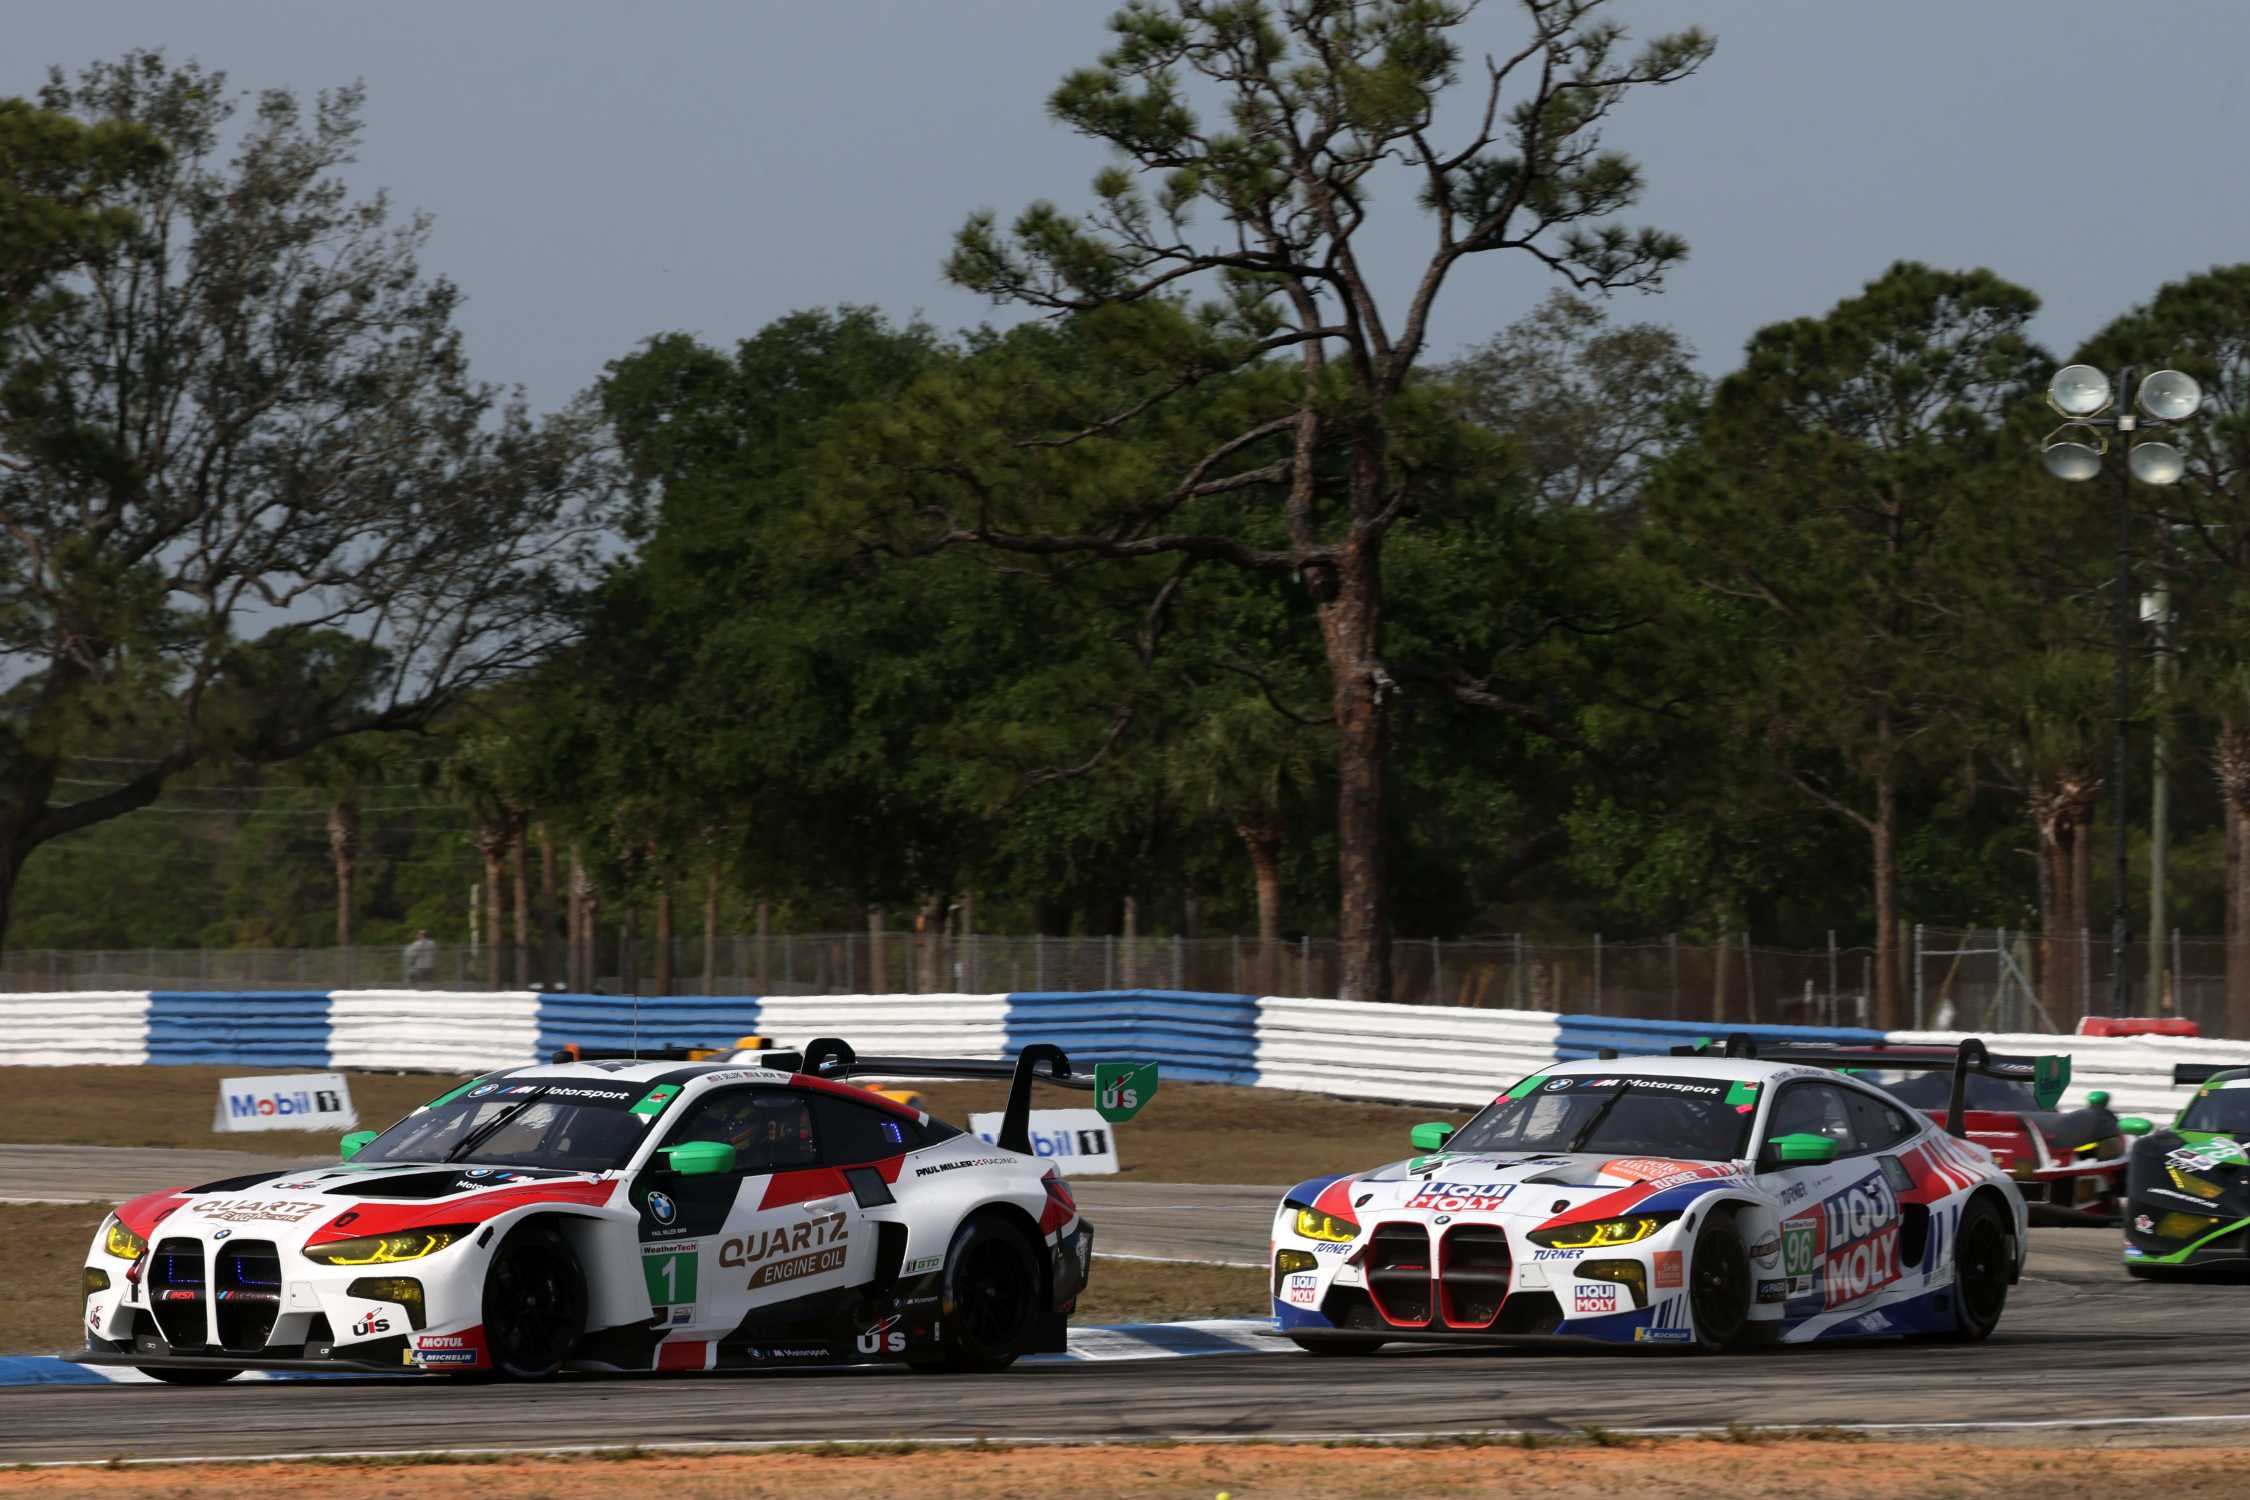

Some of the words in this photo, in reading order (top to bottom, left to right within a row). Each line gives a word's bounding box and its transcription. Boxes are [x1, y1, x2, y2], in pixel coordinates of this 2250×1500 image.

[1623, 1079, 1721, 1095] Motorsport
[230, 1091, 310, 1118] Mobil
[317, 1091, 340, 1112] 1
[1079, 1131, 1104, 1154] 1
[915, 1165, 940, 1177] PAUL
[939, 1160, 973, 1172] MILLER
[982, 1157, 1017, 1165] RACING
[1650, 1171, 1699, 1189] TURNER
[1421, 1184, 1509, 1198] LIQUI
[192, 1200, 326, 1213] QUARTZ
[1409, 1196, 1502, 1211] MOLY
[1827, 1175, 1896, 1250] LIQUI
[719, 1211, 848, 1269] QUARTZ
[643, 1243, 696, 1254] WeatherTech
[1313, 1242, 1353, 1255] TURNER
[1533, 1249, 1584, 1260] TURNER
[1787, 1231, 1811, 1273] 96
[764, 1256, 817, 1283] ENGINE
[821, 1250, 843, 1269] OIL
[917, 1258, 939, 1270] GTD
[1828, 1230, 1899, 1306] MOLY
[662, 1255, 676, 1302] 1
[1292, 1277, 1316, 1289] LIQUI
[1292, 1290, 1315, 1302] MOLY
[1575, 1285, 1615, 1298] LIQUI
[1576, 1299, 1616, 1311] MOLY
[422, 1337, 464, 1347] MOTUL
[425, 1353, 472, 1361] MICHELIN
